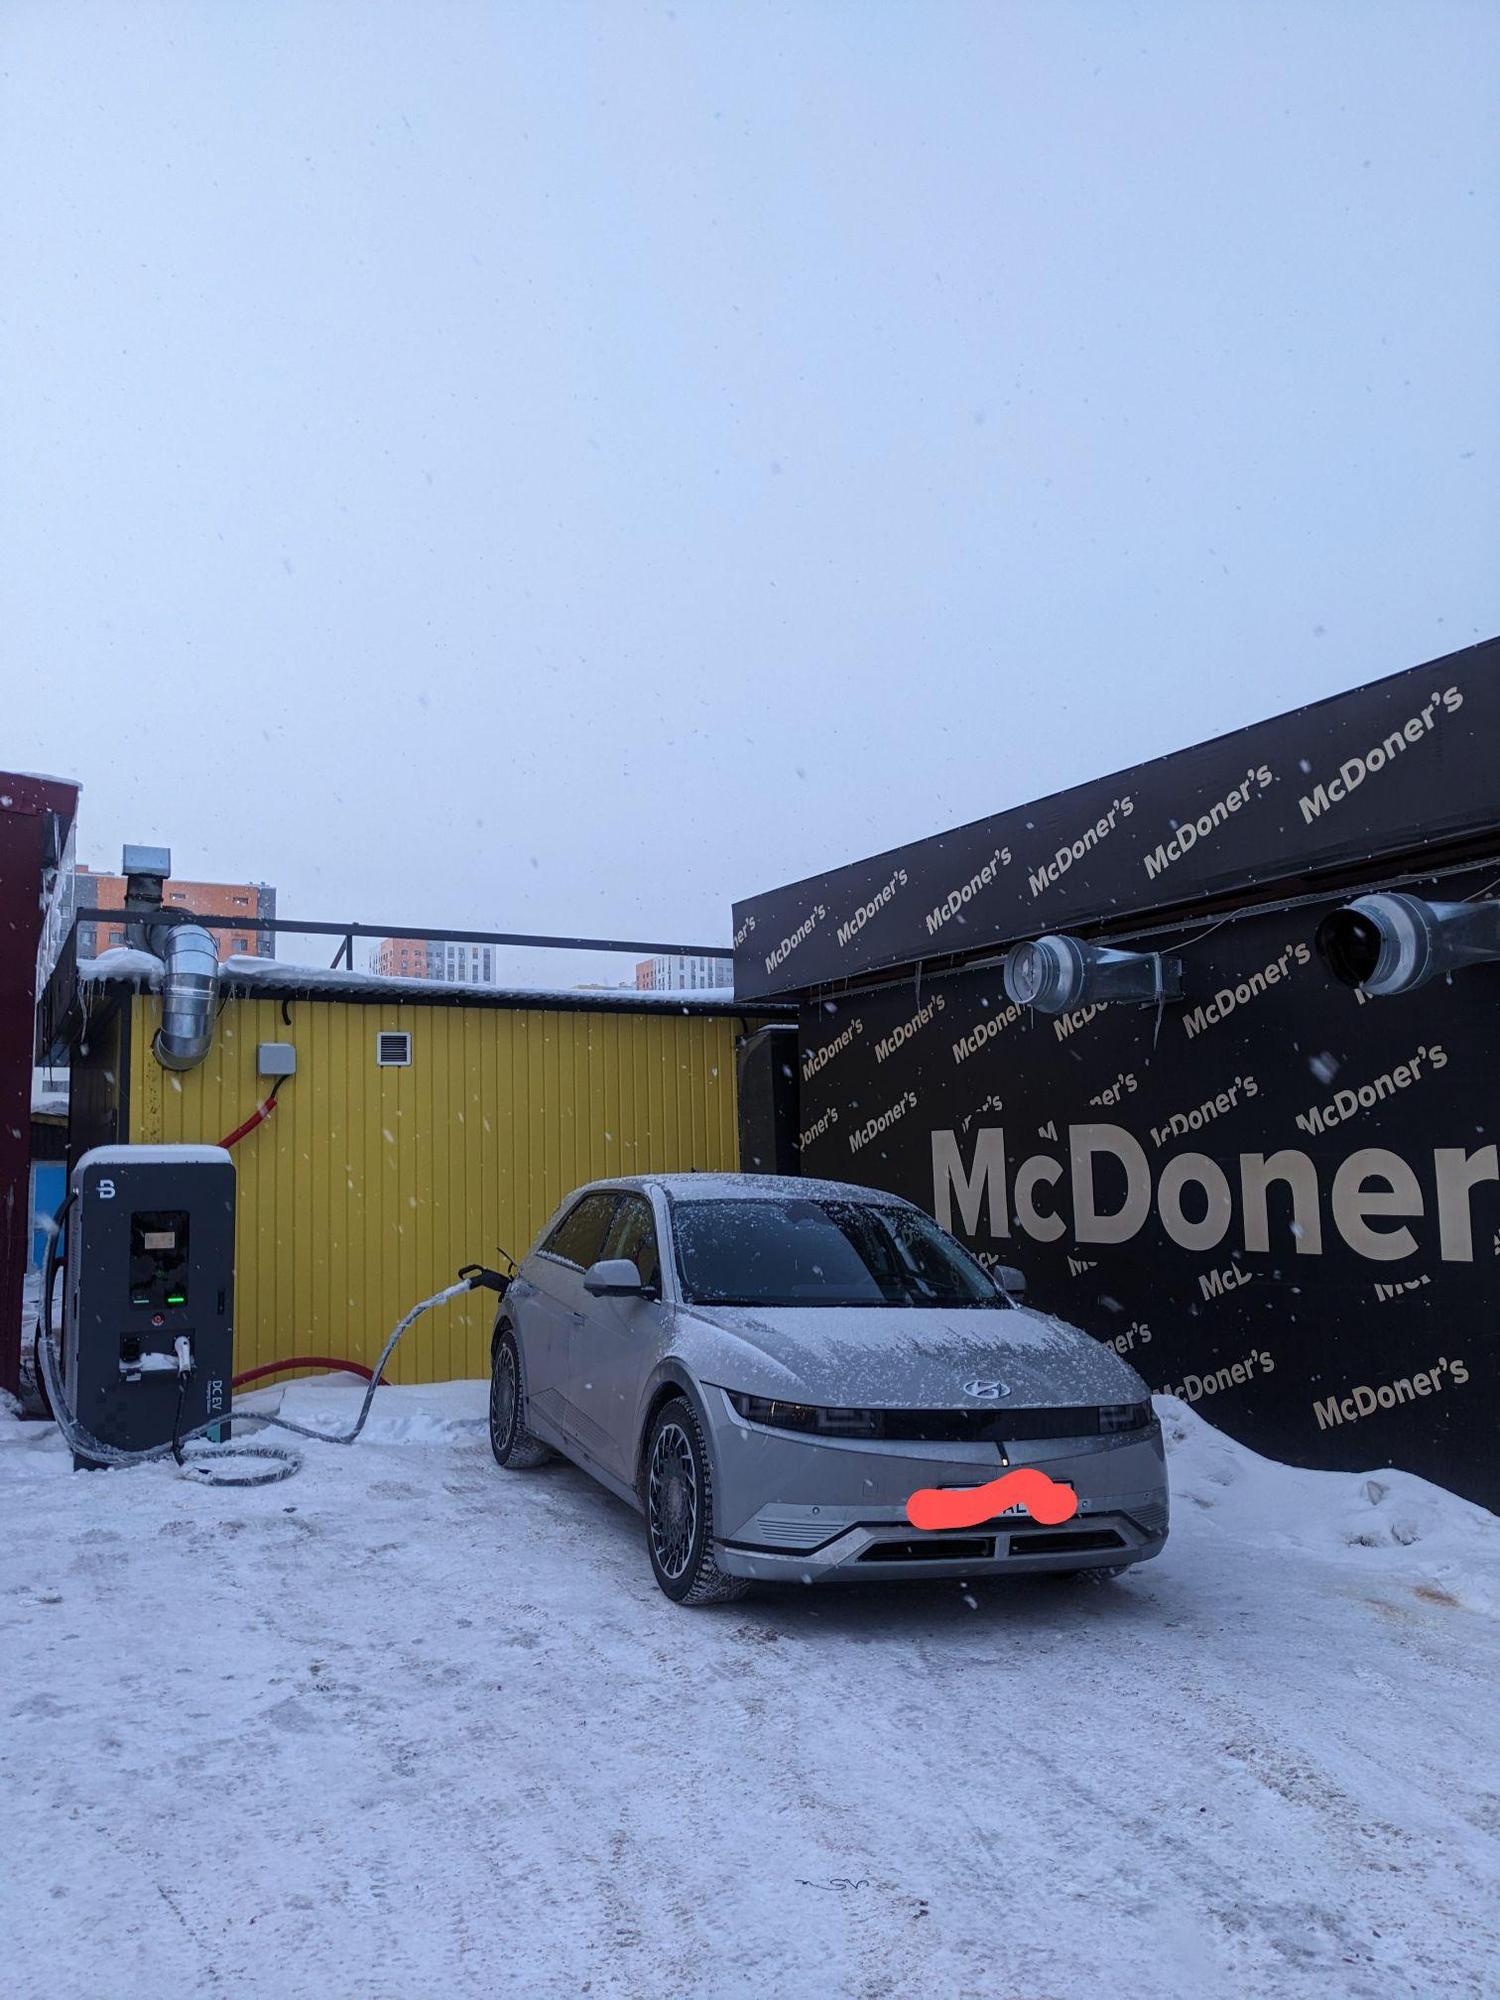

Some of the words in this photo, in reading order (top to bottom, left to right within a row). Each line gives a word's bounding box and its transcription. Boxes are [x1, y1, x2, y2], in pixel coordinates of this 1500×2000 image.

[1298, 686, 1464, 824] McDoner's
[1028, 795, 1134, 898] McDoner's
[1143, 764, 1273, 880] McDoner's
[836, 868, 908, 947] McDoner's
[925, 846, 1012, 935] McDoner's
[733, 915, 756, 950] ner's
[764, 904, 826, 974] McDoner's
[1182, 943, 1312, 1039] McDoner's
[802, 1017, 864, 1081] McDoner's
[874, 995, 945, 1064] McDoner's
[848, 1091, 918, 1153] McDoner's
[1296, 1044, 1449, 1136] McDoner's
[212, 1380, 222, 1395] DC
[212, 1397, 222, 1410] EV
[1313, 1357, 1470, 1431] McDoner's
